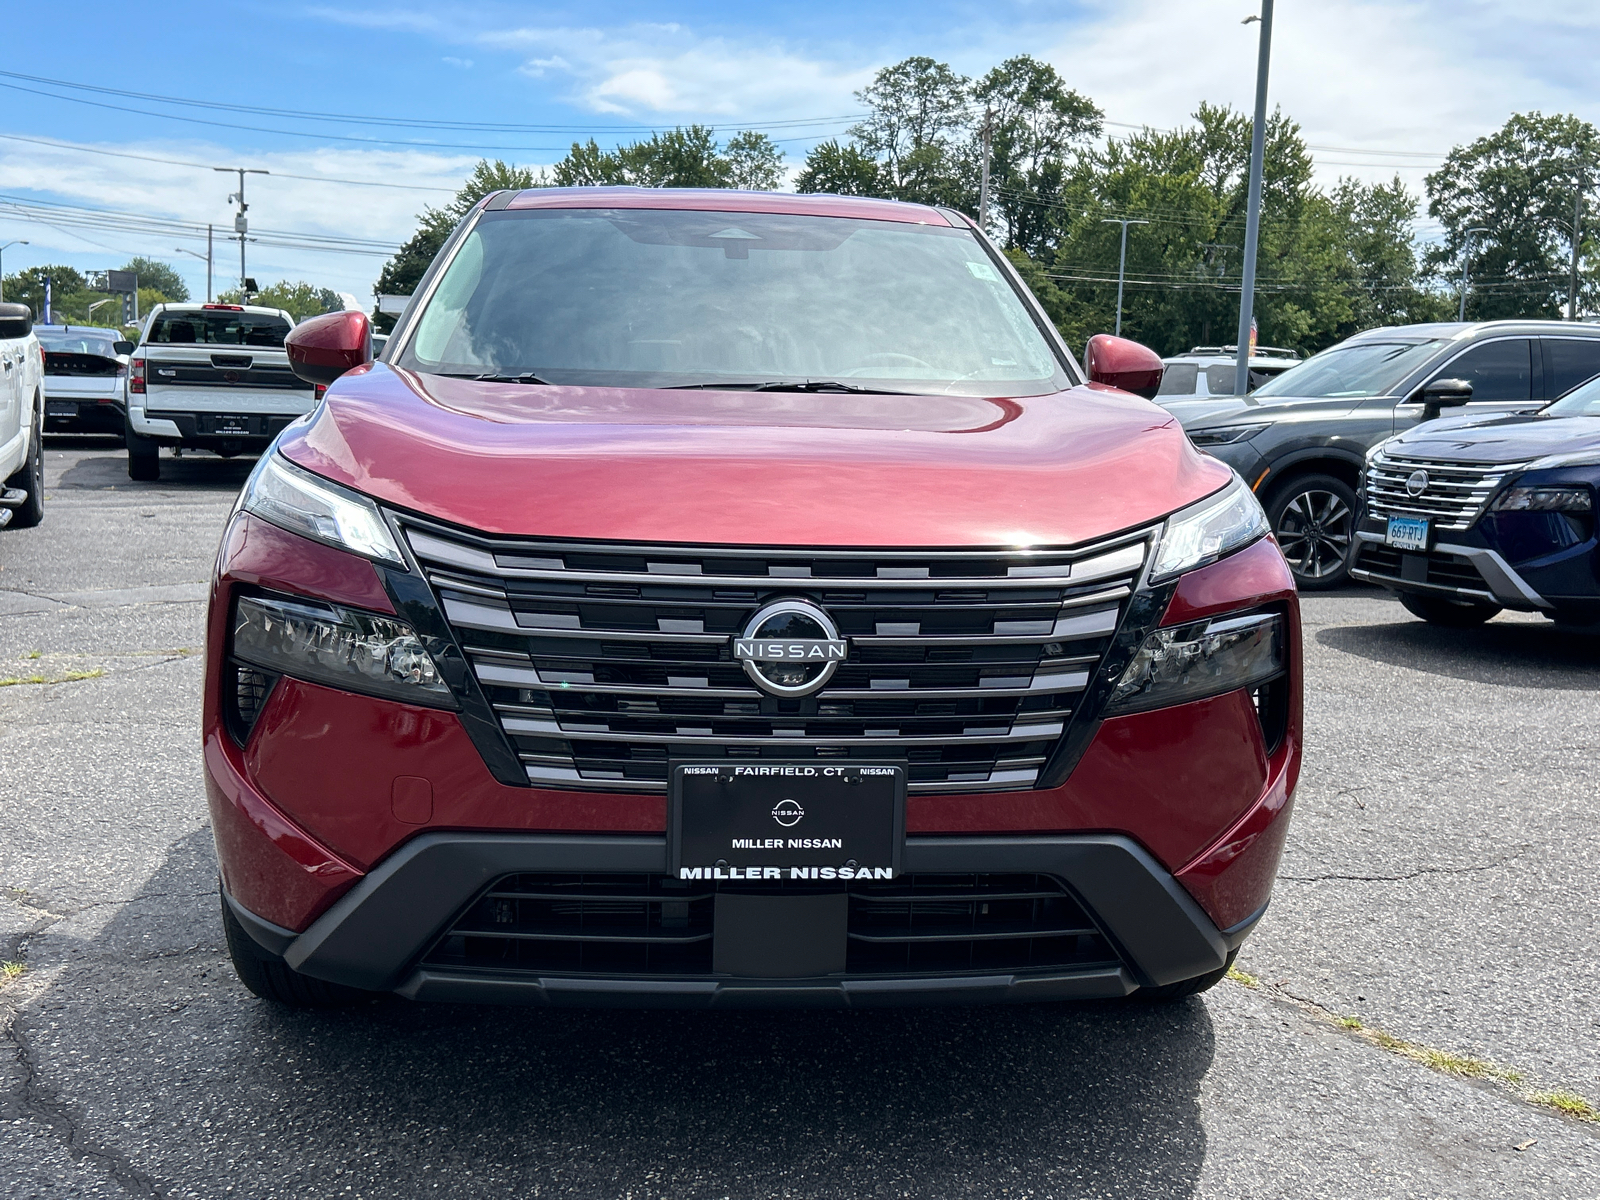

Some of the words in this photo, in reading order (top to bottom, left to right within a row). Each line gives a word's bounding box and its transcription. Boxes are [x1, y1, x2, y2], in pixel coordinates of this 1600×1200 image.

[736, 642, 844, 658] NISSAN
[684, 767, 719, 775] NISSAN
[735, 767, 819, 777] FAIRFIELD,
[823, 767, 845, 776] CT
[860, 768, 895, 776] NISSAN
[732, 839, 784, 849] MILLER
[787, 839, 842, 849] NISSAN
[680, 867, 781, 880] MILLER
[790, 867, 893, 880] NISSAN
